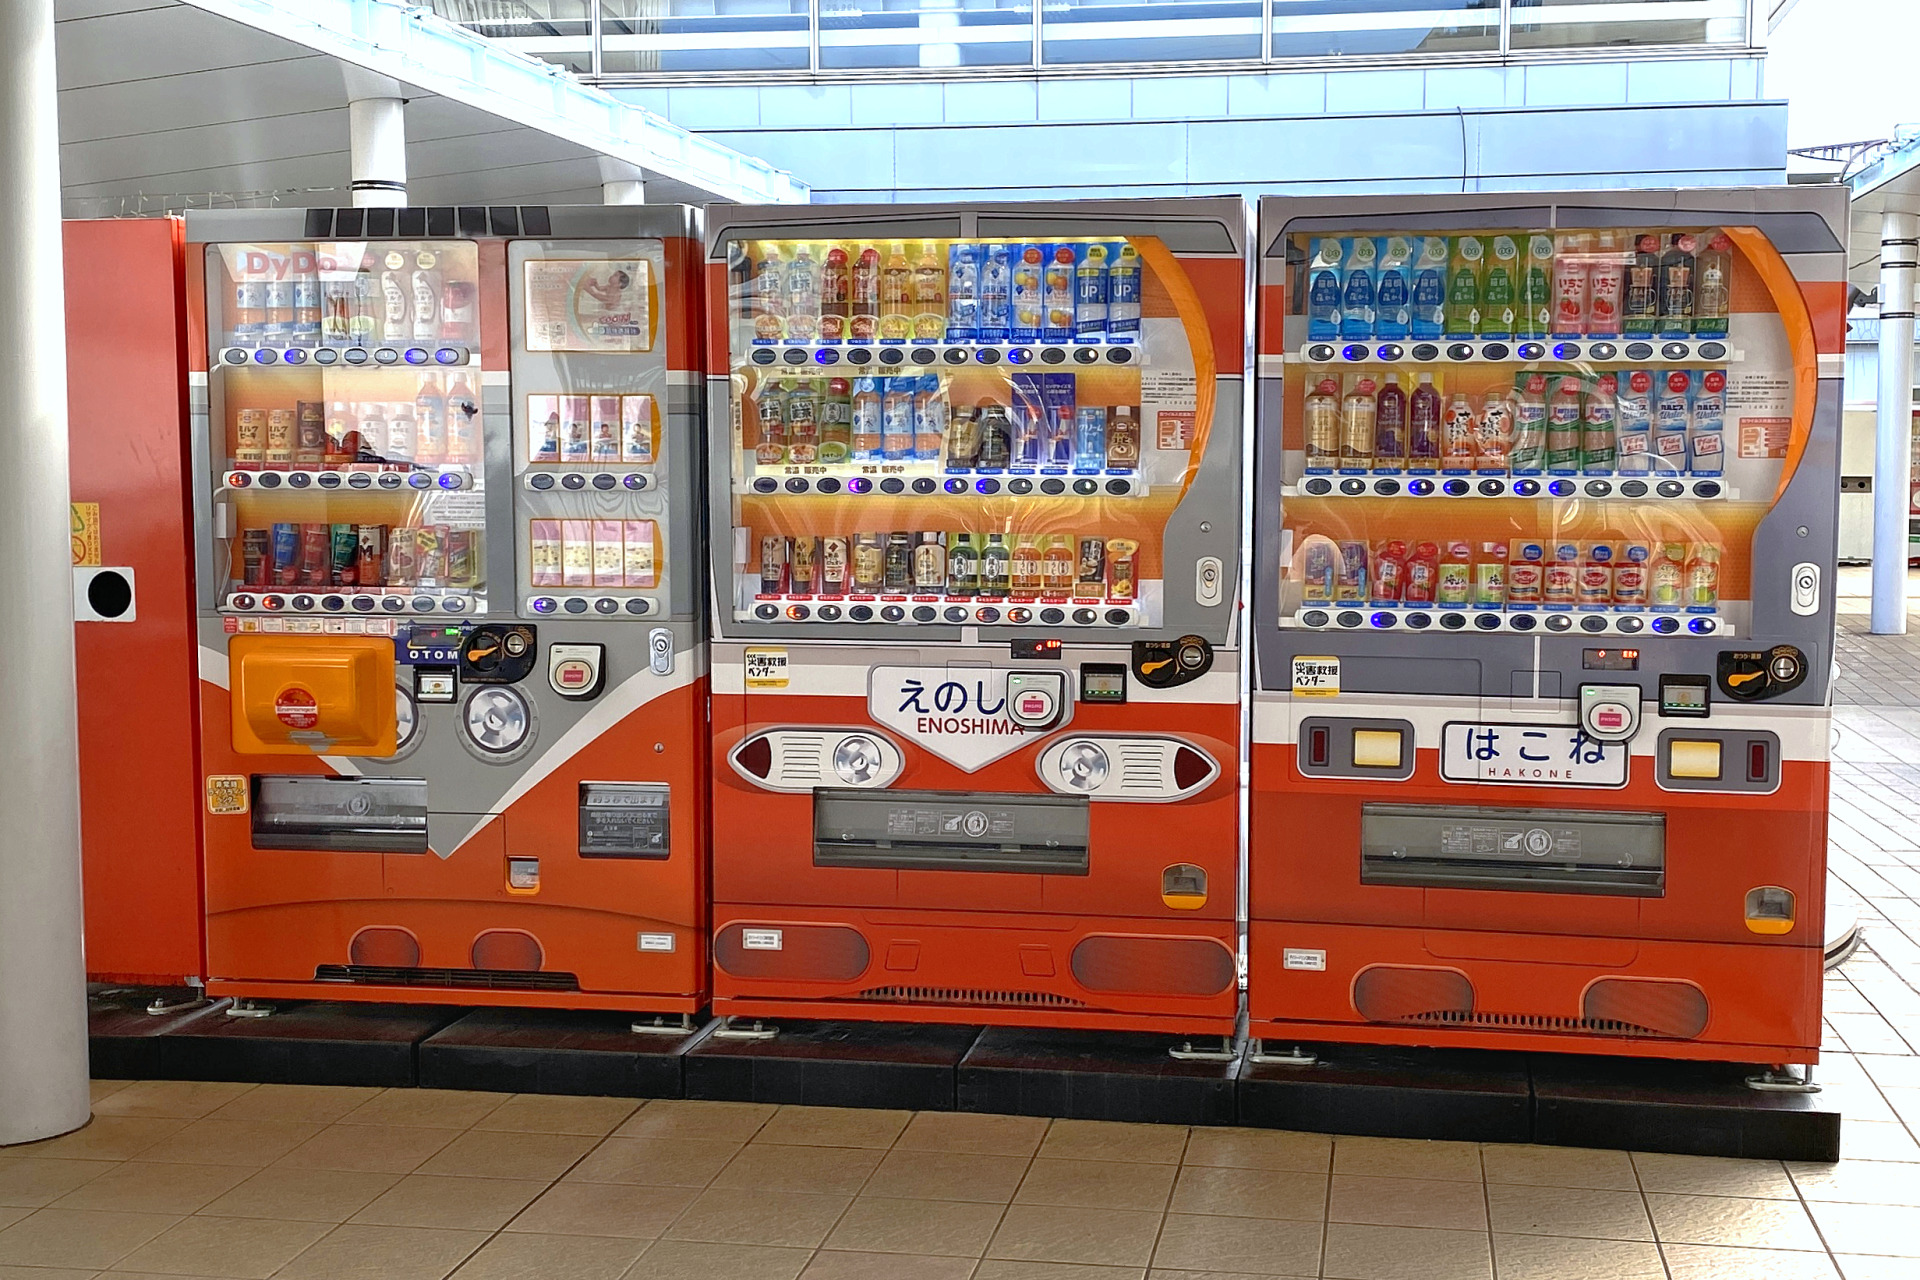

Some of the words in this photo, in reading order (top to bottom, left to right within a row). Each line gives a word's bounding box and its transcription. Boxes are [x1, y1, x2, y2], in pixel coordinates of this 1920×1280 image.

[1559, 278, 1585, 288] いちご
[1592, 277, 1619, 288] いちご
[1081, 286, 1098, 298] UP
[1114, 285, 1132, 297] UP
[1659, 410, 1685, 419] Water
[1696, 410, 1722, 419] Water
[804, 466, 827, 474] 販売中
[881, 466, 905, 474] 販売中
[747, 654, 787, 667] 災害救援
[748, 666, 775, 677] ベンダー
[1295, 662, 1338, 675] 災害救援
[1295, 675, 1325, 686] ベンダー
[918, 717, 1025, 735] ENOSHIMA
[1466, 728, 1605, 764] はこね
[1488, 768, 1573, 779] HAKONE
